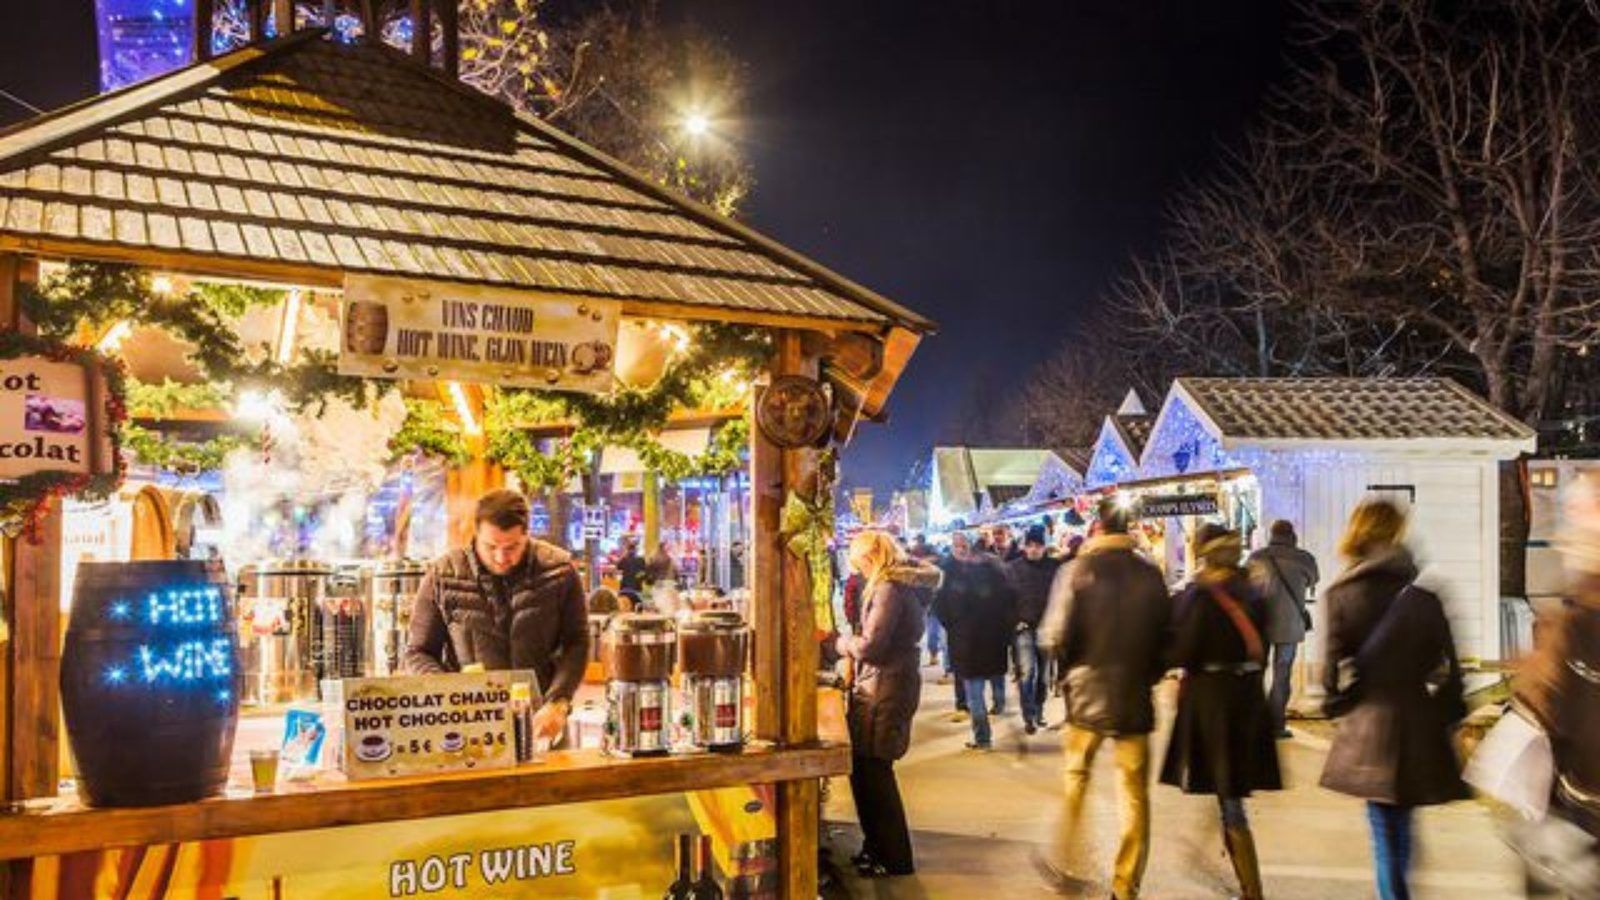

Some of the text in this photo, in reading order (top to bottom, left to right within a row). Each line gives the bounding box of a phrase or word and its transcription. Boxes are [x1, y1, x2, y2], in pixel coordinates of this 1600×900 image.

[441, 299, 533, 333] VINS CHAUD
[397, 328, 433, 357] HOT
[0, 372, 40, 391] ot
[149, 588, 219, 624] HOT
[140, 639, 231, 682] WINE
[346, 690, 510, 711] CHOCOLAT CHAUD
[355, 708, 505, 730] HOT CHOCOLATE
[390, 839, 576, 897] HOT WINE
